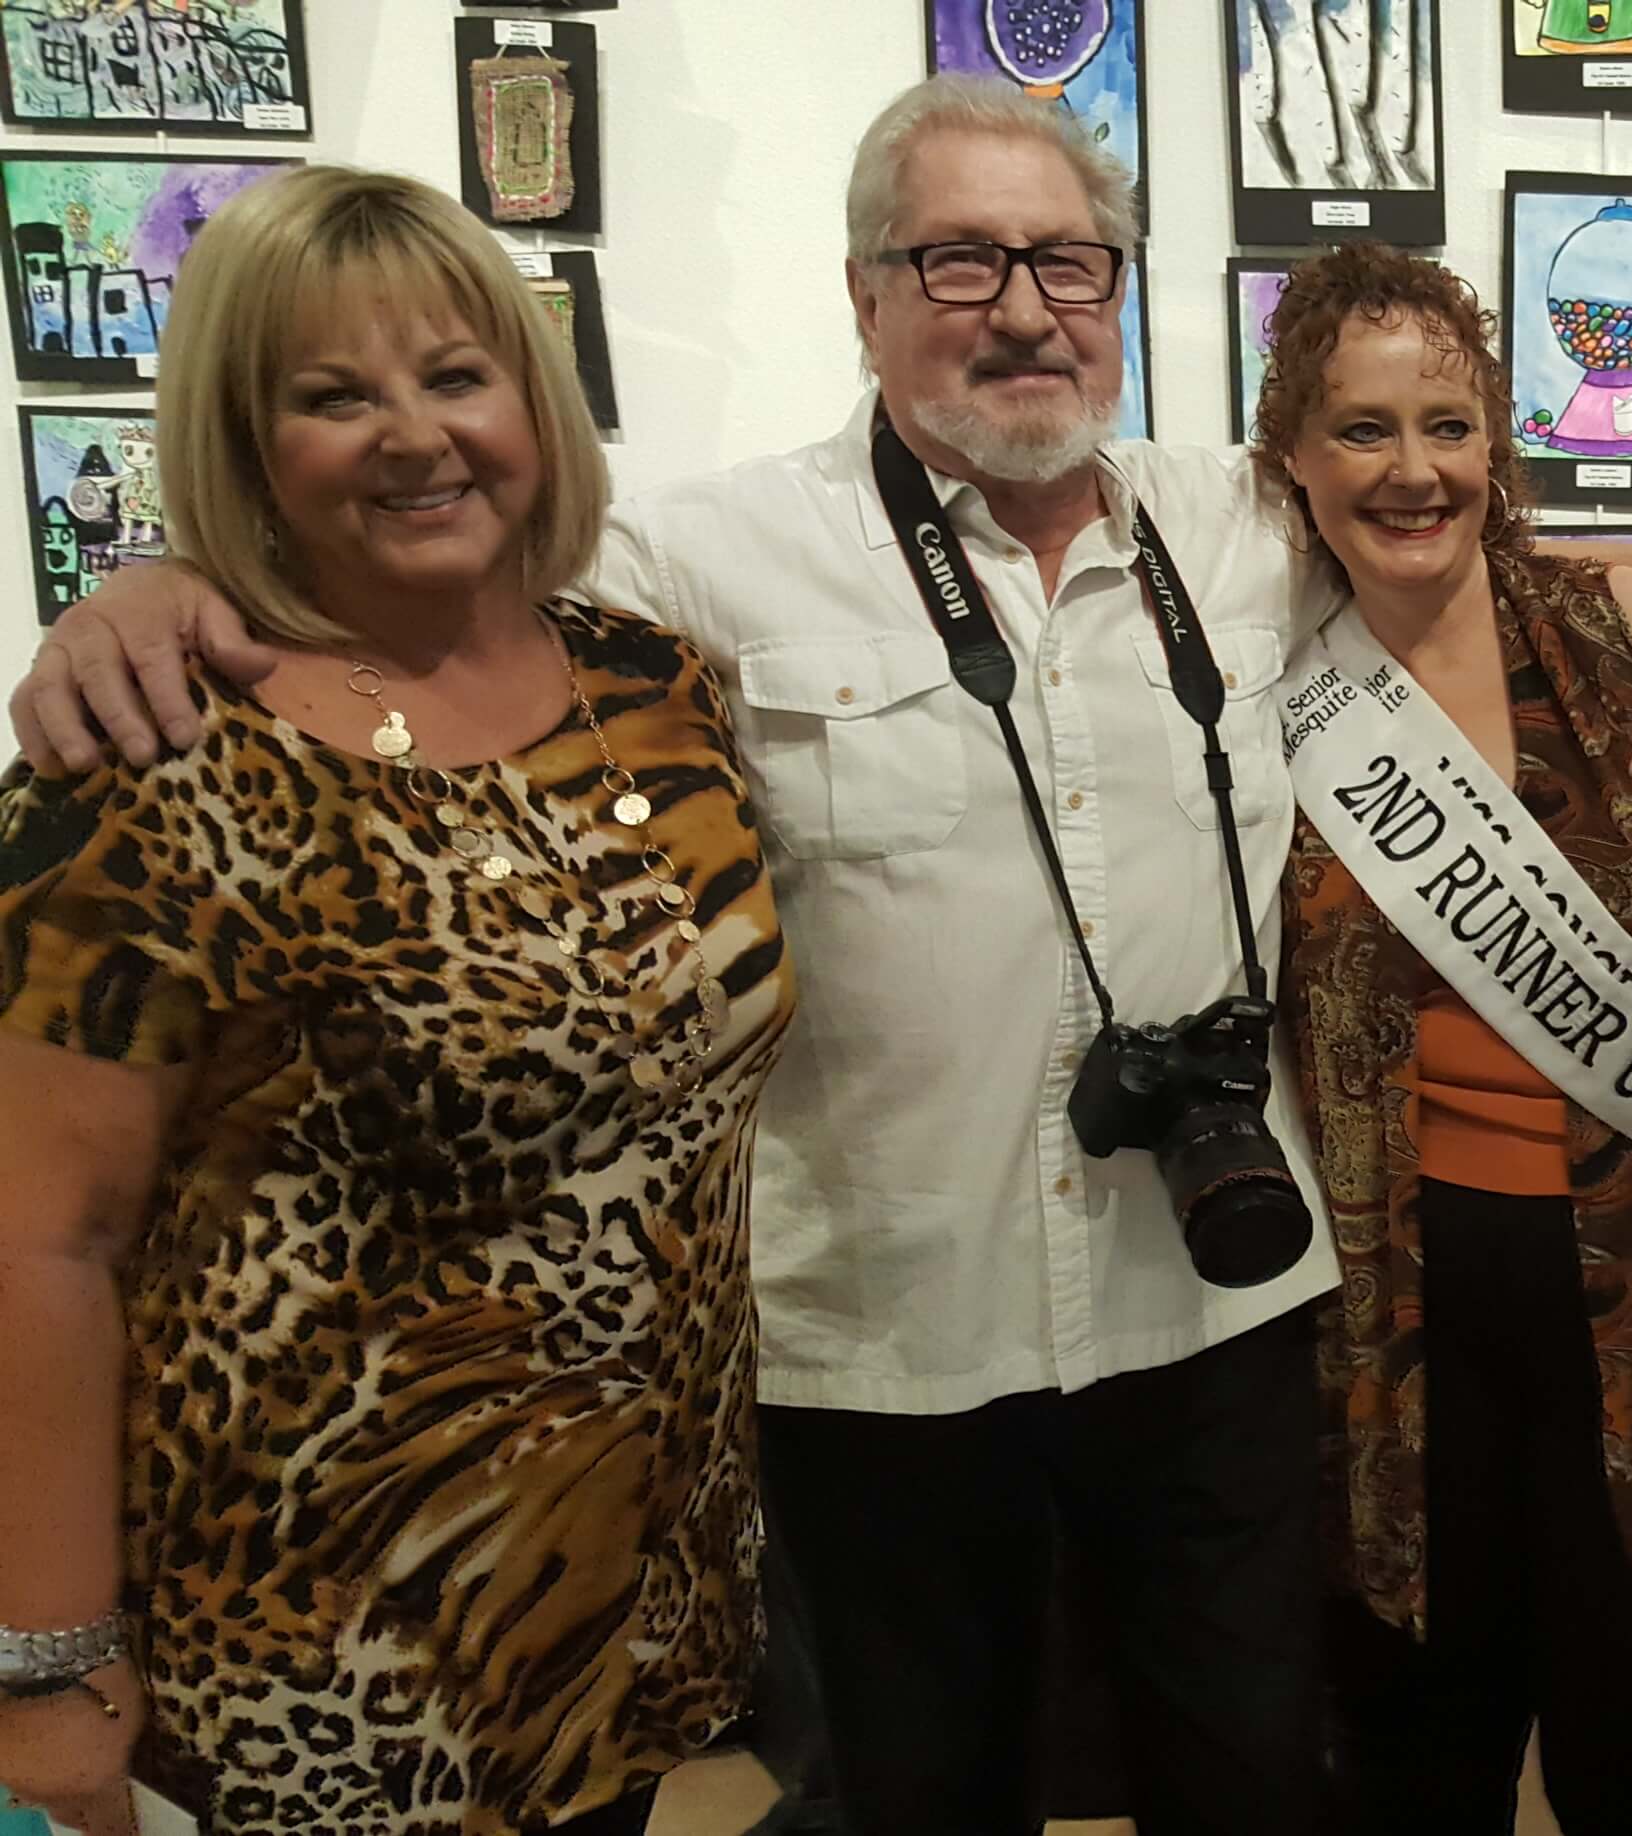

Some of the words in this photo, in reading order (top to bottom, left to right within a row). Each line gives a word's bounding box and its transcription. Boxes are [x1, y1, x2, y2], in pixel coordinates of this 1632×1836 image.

[915, 522, 970, 619] Canon
[1142, 546, 1188, 643] DIGITAL
[1284, 685, 1358, 764] Mesquite
[1287, 667, 1341, 717] Senior
[1332, 755, 1447, 862] 2ND
[1415, 843, 1628, 1068] RUNNER
